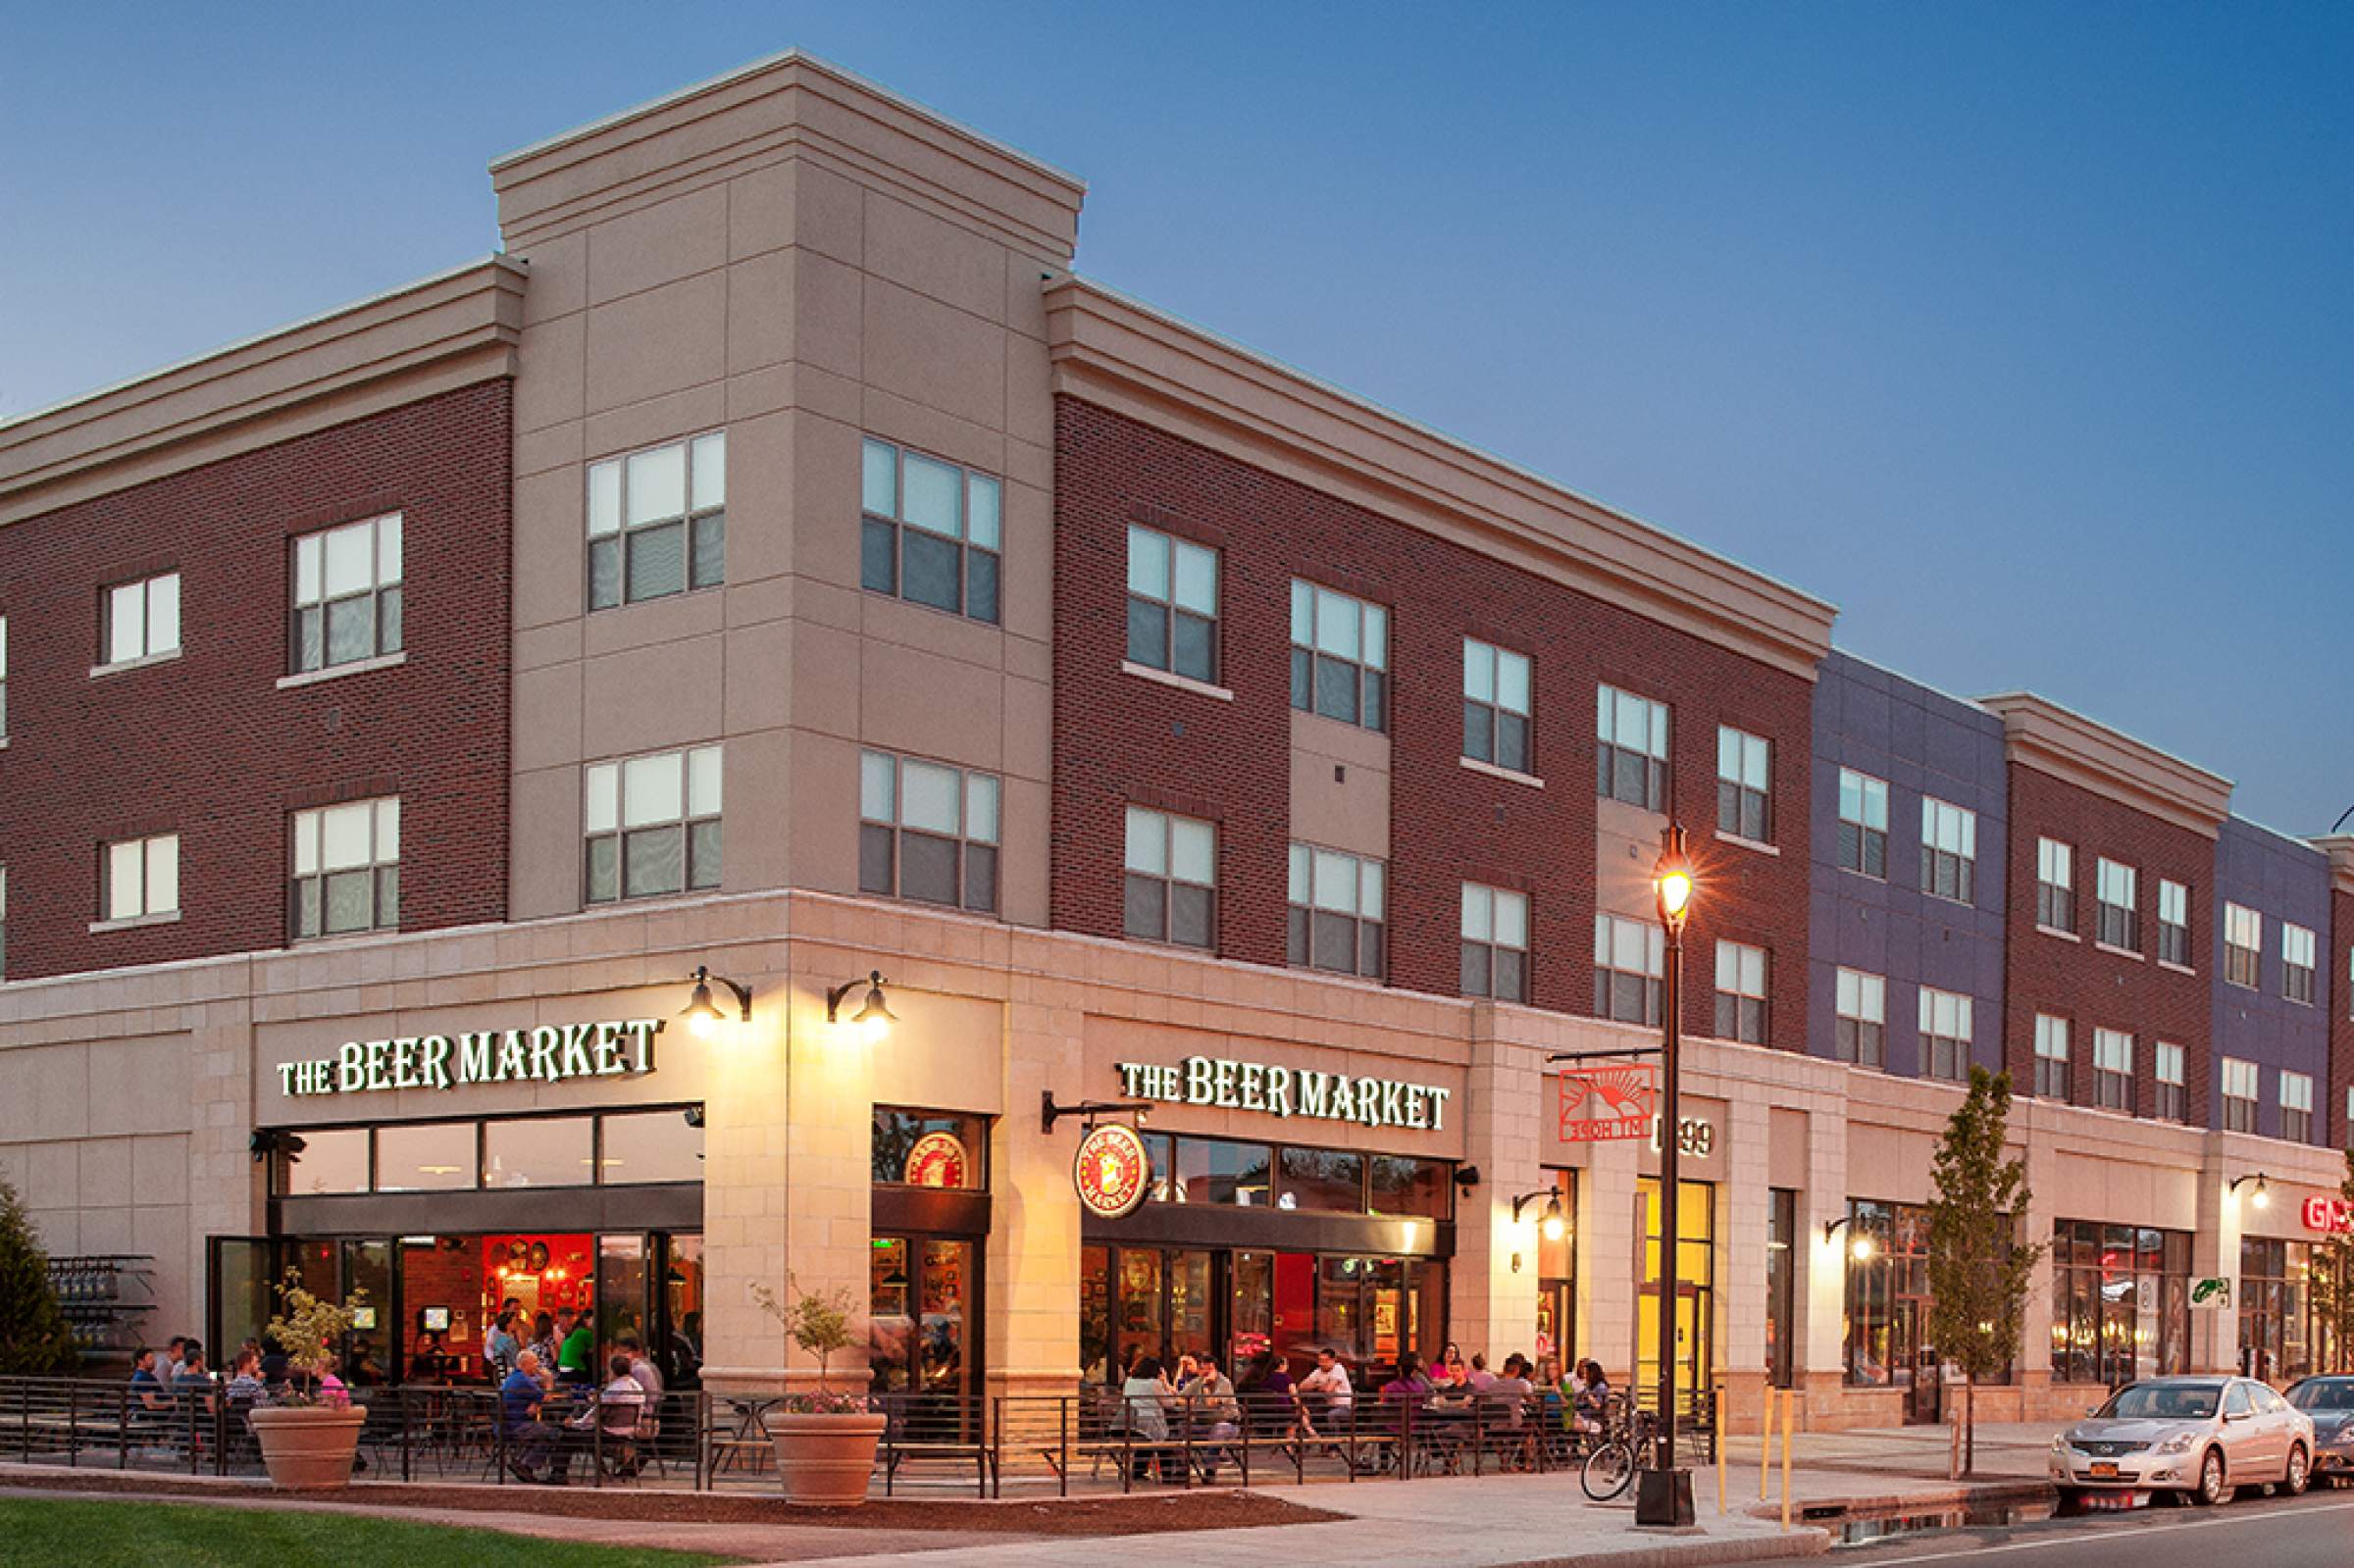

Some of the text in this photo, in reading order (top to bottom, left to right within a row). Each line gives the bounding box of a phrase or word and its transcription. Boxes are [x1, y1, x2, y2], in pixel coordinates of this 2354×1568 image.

[276, 1018, 662, 1096] THE BEER MARKET
[1121, 1055, 1452, 1131] THE BEER MARKET
